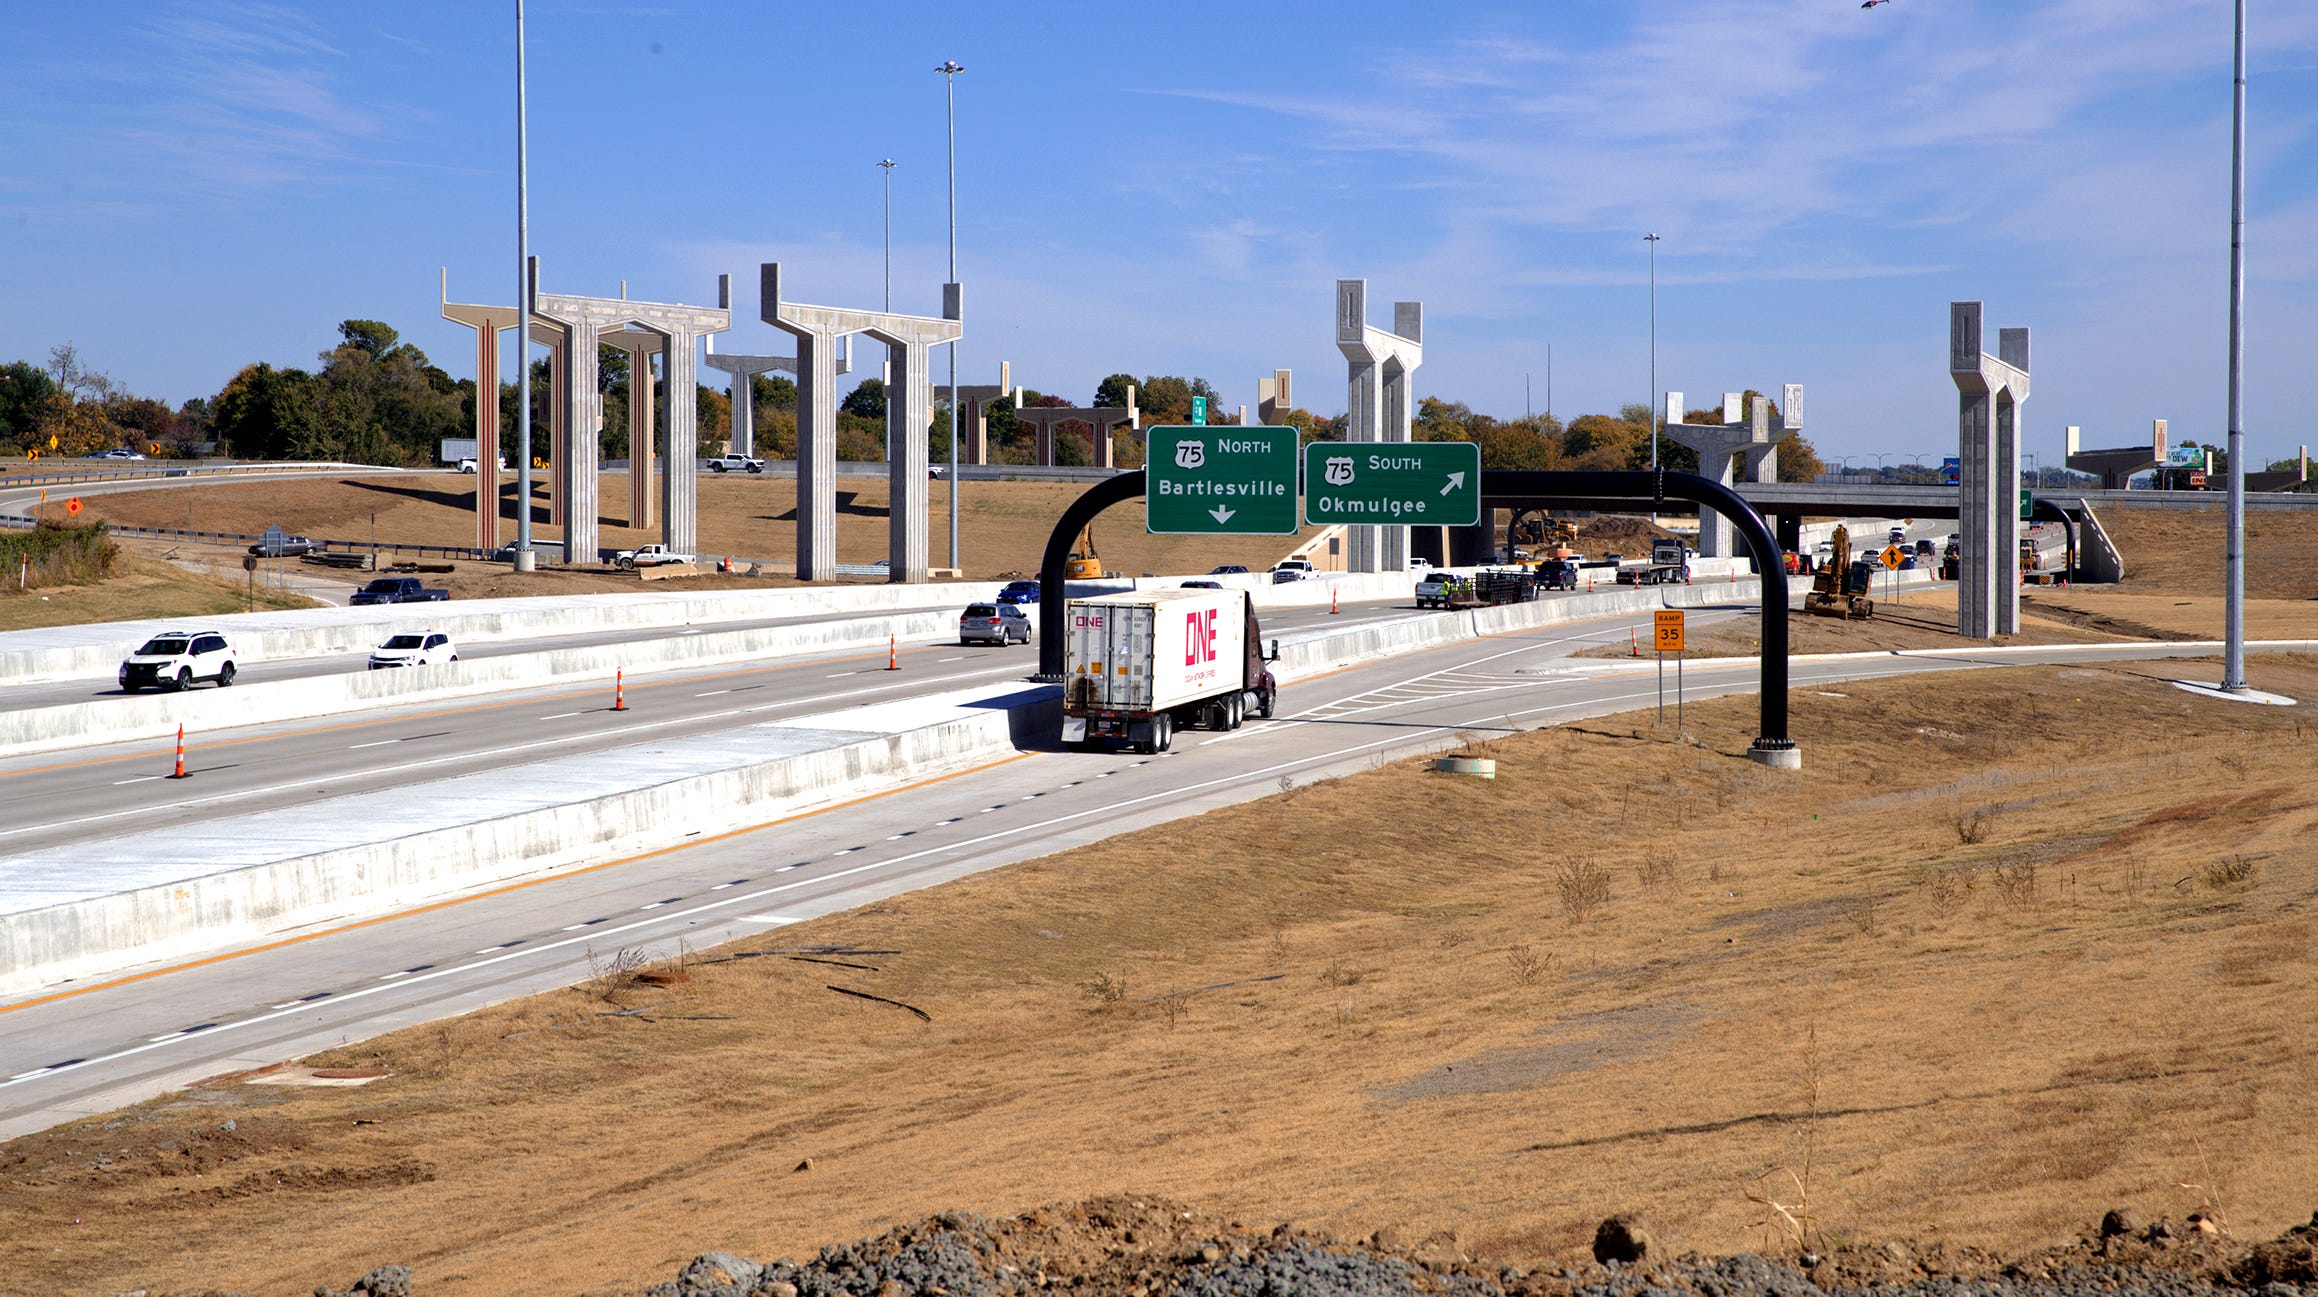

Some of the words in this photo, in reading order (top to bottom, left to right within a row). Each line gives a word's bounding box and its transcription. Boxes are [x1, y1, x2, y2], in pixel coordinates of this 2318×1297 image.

[1179, 446, 1202, 463] 75
[1218, 438, 1271, 453] NORTH
[1328, 463, 1352, 480] 75
[1369, 455, 1421, 470] SOUTH
[1159, 479, 1285, 495] Bartlesville
[1319, 496, 1426, 517] Okmulgee
[1075, 616, 1103, 627] ONE
[1185, 608, 1217, 666] ONE
[1660, 629, 1679, 640] 35
